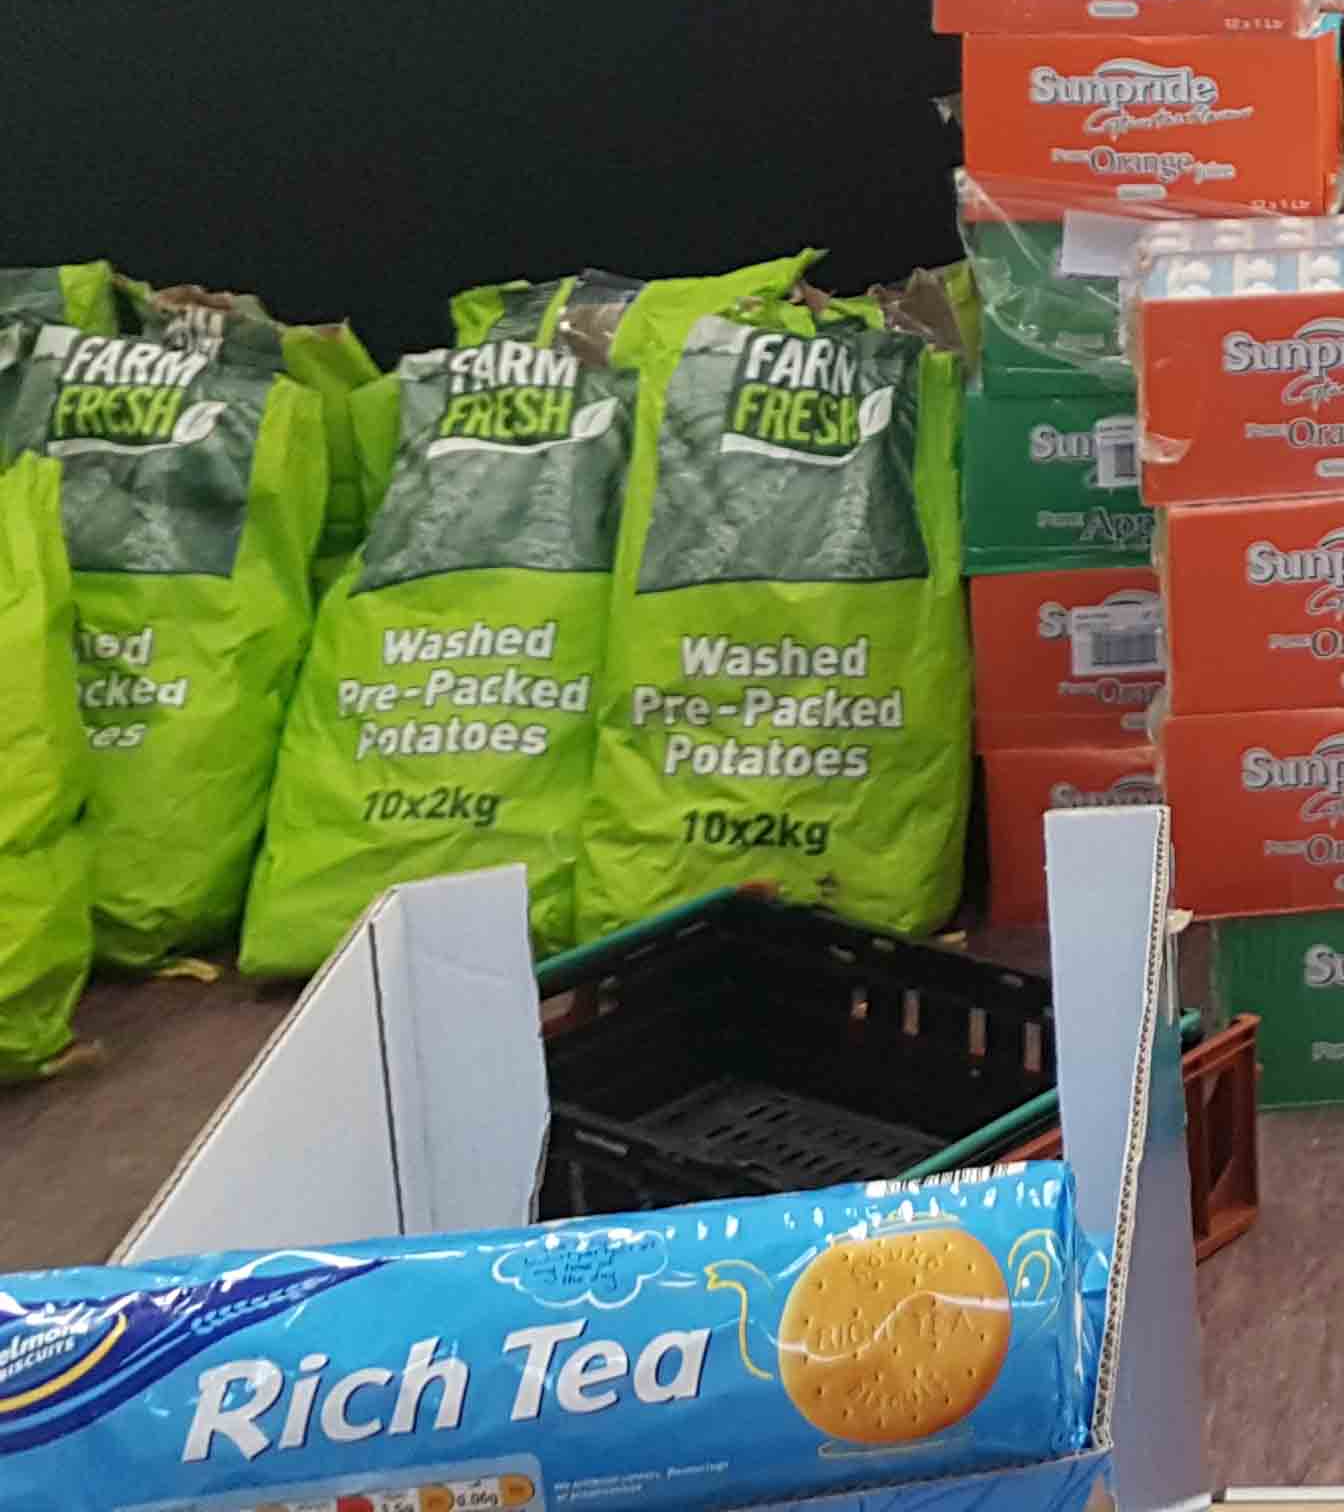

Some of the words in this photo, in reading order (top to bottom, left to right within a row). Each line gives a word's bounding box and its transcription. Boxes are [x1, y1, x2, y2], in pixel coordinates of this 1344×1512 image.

[1030, 64, 1219, 111] Sunpride
[1089, 145, 1195, 185] Orange
[62, 336, 208, 386] FARM
[450, 340, 579, 393] FARM
[54, 384, 184, 438] FRESH
[440, 386, 575, 438] FRESH
[382, 620, 557, 666] Washed
[681, 635, 869, 678] Washed
[338, 666, 592, 716] Pre-Packed
[631, 685, 904, 728] Pre-Packed
[355, 715, 549, 761] Potatoes
[663, 733, 869, 778] Potatoes
[362, 787, 503, 827] 10x2kg
[682, 809, 832, 855] 10x2kg
[181, 1334, 471, 1464] Rich
[501, 1317, 712, 1423] Tea
